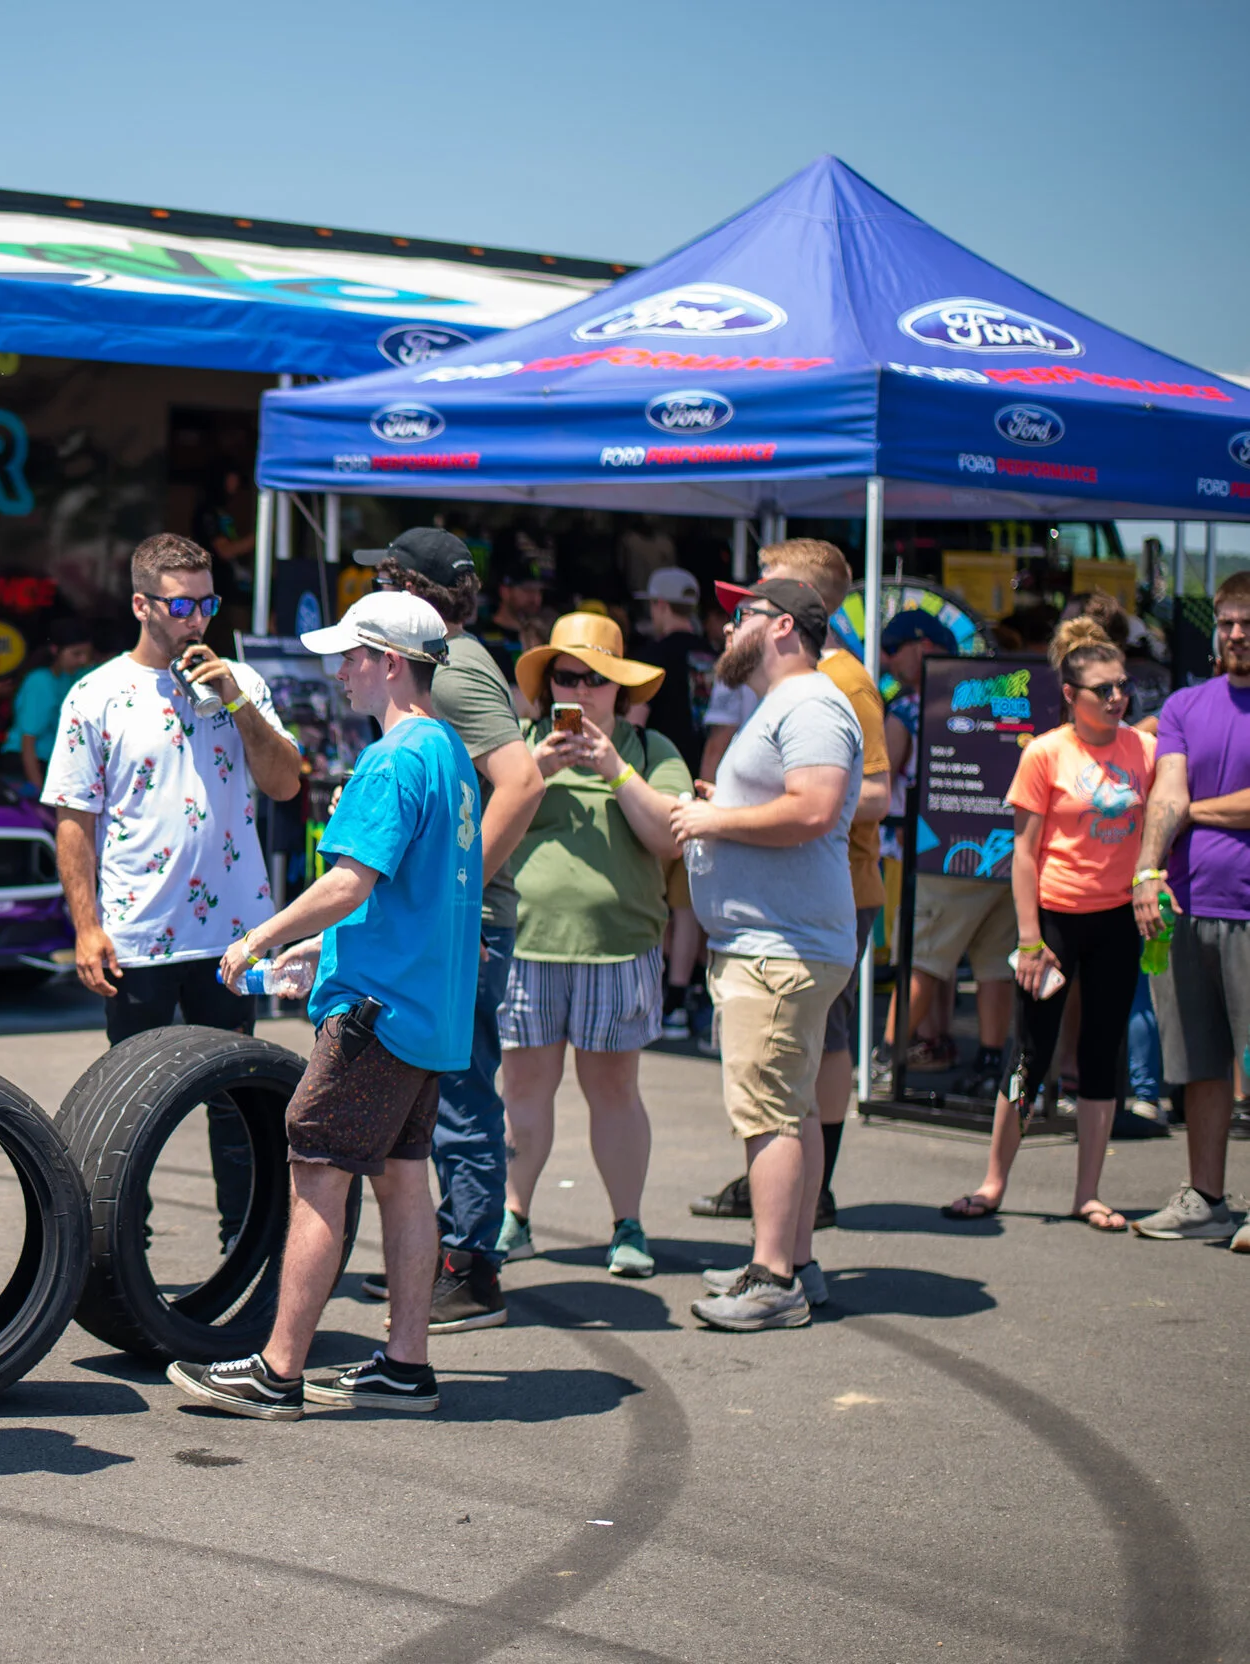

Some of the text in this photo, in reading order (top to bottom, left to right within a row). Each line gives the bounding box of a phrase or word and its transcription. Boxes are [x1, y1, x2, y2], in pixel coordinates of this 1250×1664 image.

[940, 306, 1055, 350] Ford
[370, 453, 481, 471] PERFORMANCE
[600, 444, 778, 467] FORD PERFORMANCE
[958, 453, 1098, 484] FORD PERFORMANCE
[1197, 477, 1230, 497] FORD
[991, 697, 1031, 718] TOUR
